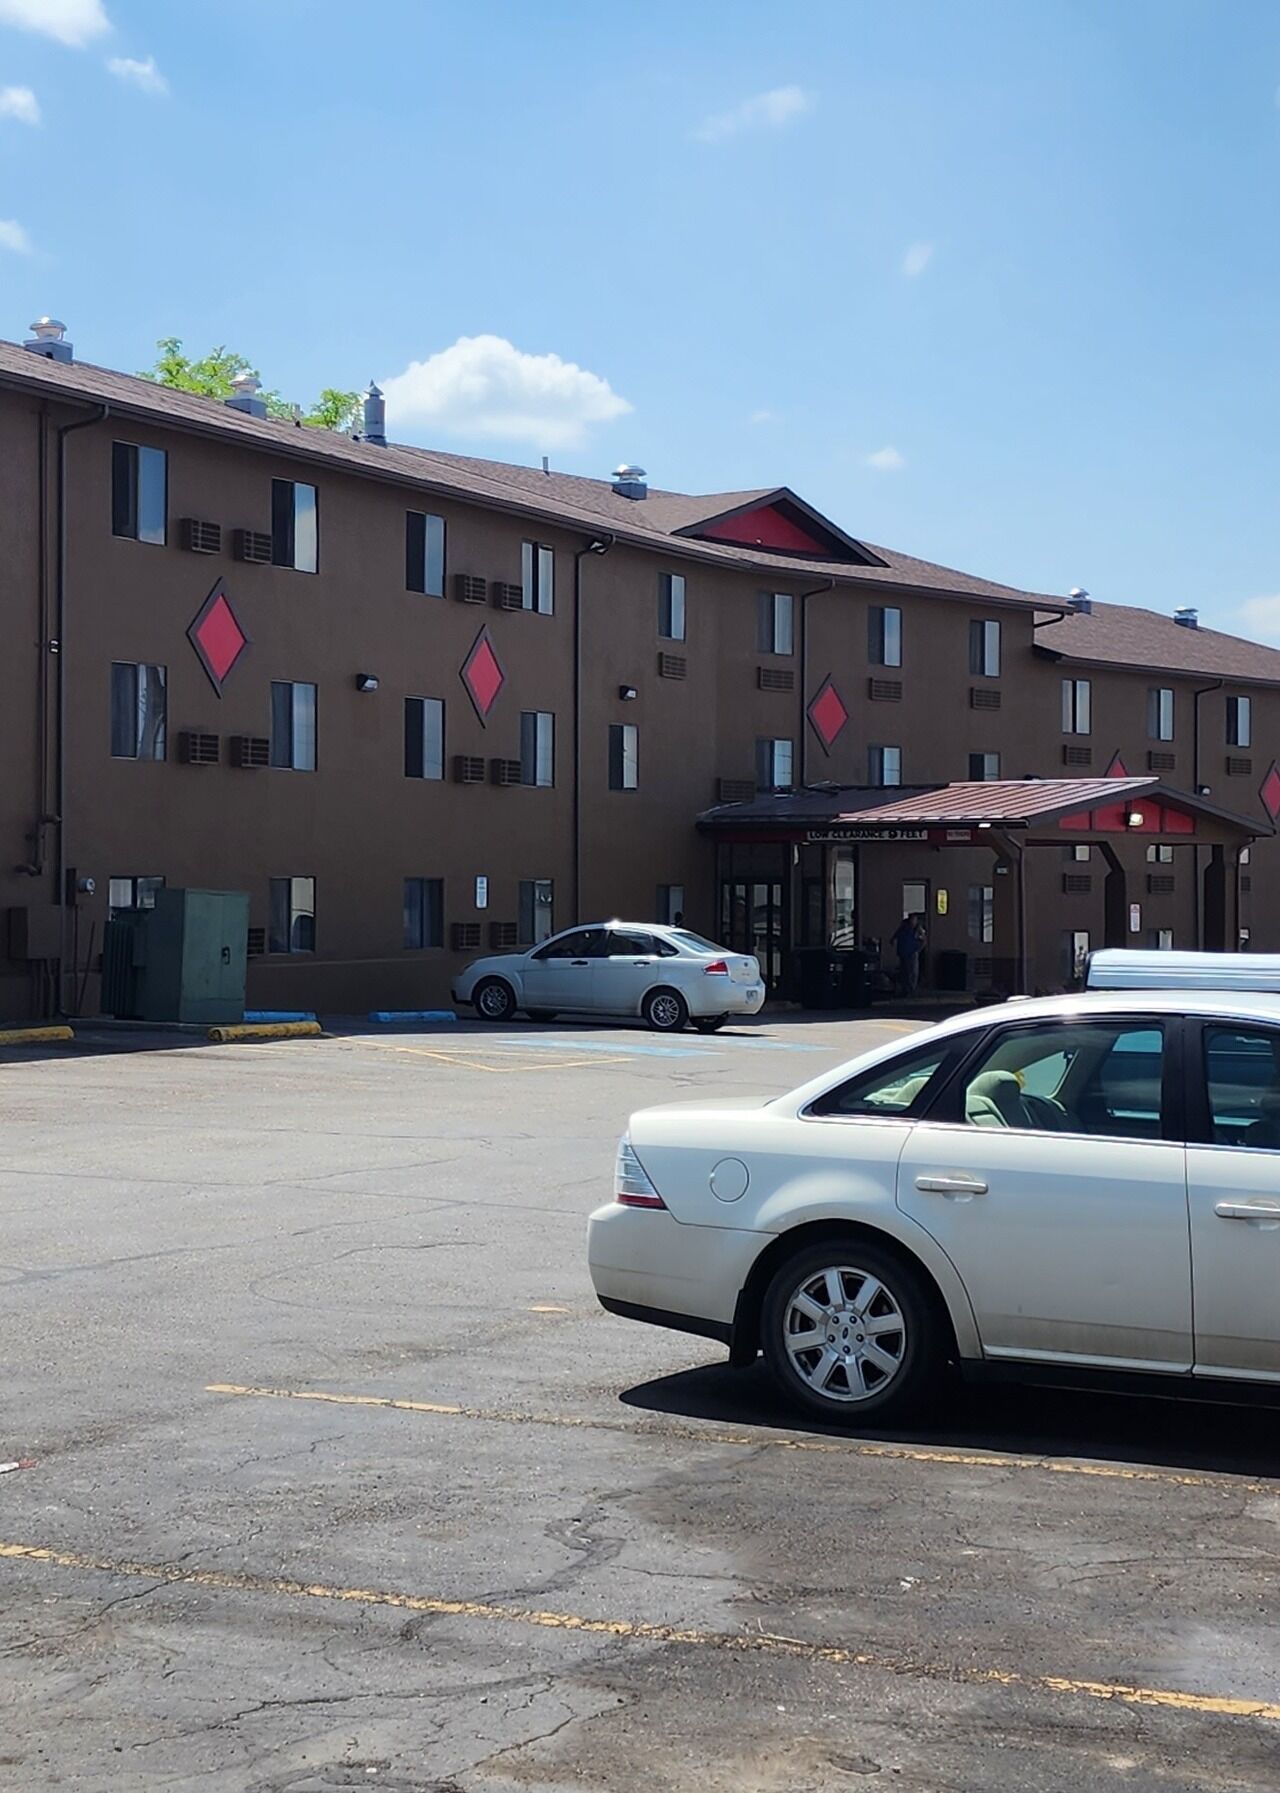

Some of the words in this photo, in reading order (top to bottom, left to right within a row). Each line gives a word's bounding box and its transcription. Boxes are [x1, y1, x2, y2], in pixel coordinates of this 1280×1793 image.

[809, 830, 829, 839] LOW
[832, 830, 885, 839] CLEARANCE
[900, 830, 924, 839] FEET
